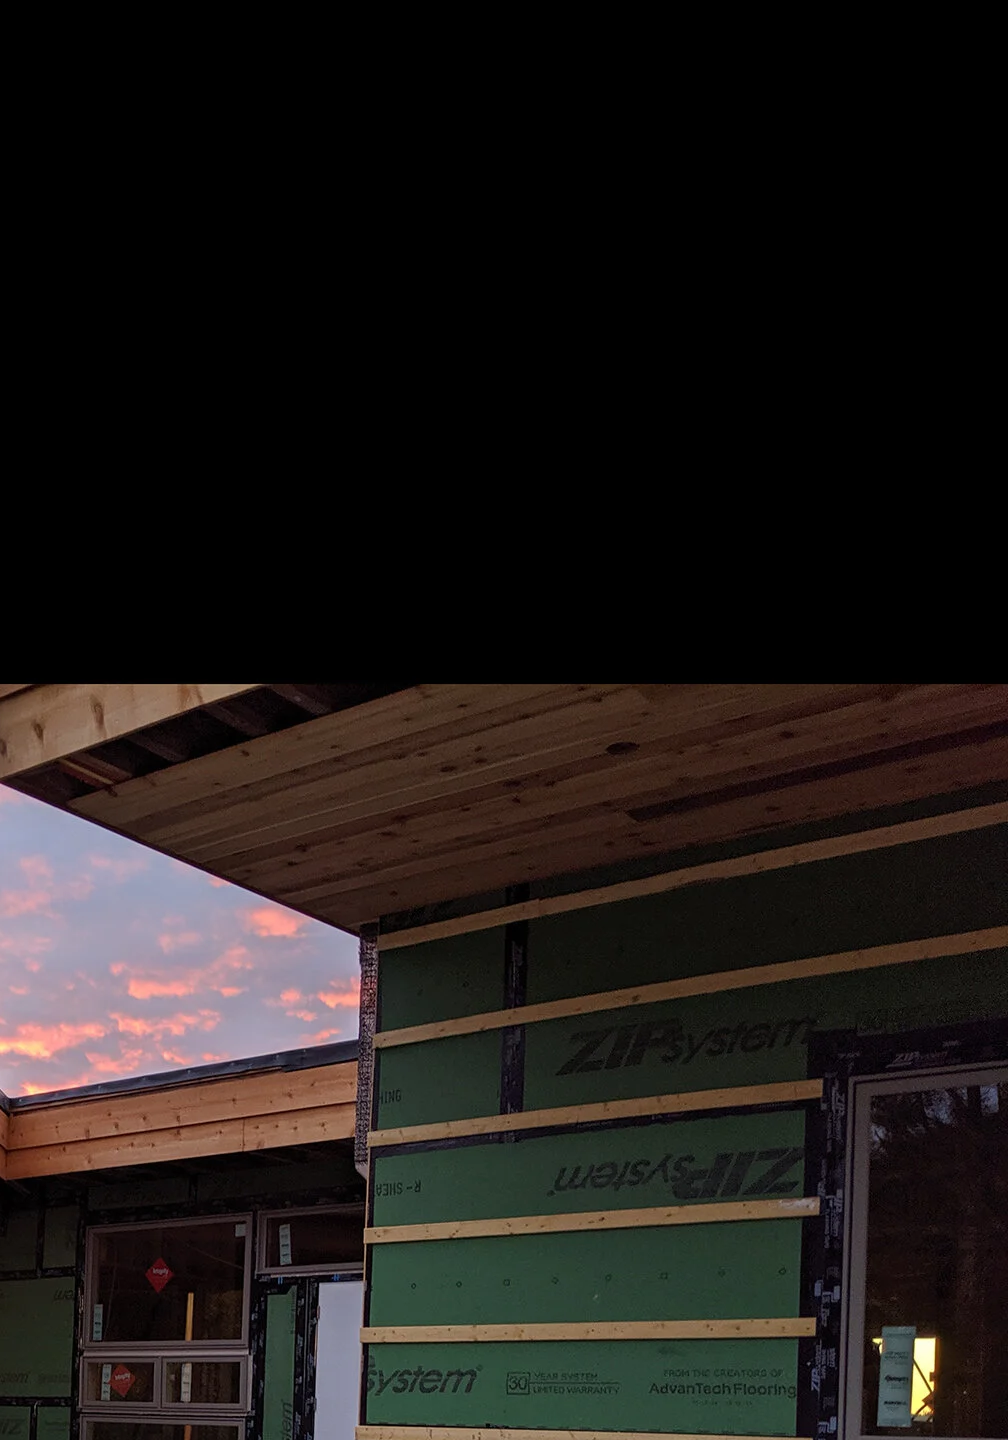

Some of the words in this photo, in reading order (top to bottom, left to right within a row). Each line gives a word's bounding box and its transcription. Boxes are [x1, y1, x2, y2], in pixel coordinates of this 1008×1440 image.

[533, 1372, 559, 1381] YEAR
[560, 1372, 598, 1382] SYSTEM
[663, 1369, 690, 1378] FROM
[693, 1369, 708, 1377] THE
[713, 1369, 767, 1378] CREATORS
[771, 1369, 784, 1377] OF
[508, 1376, 528, 1392] 30
[533, 1385, 565, 1395] LIMITED
[566, 1385, 620, 1396] WARRANTY
